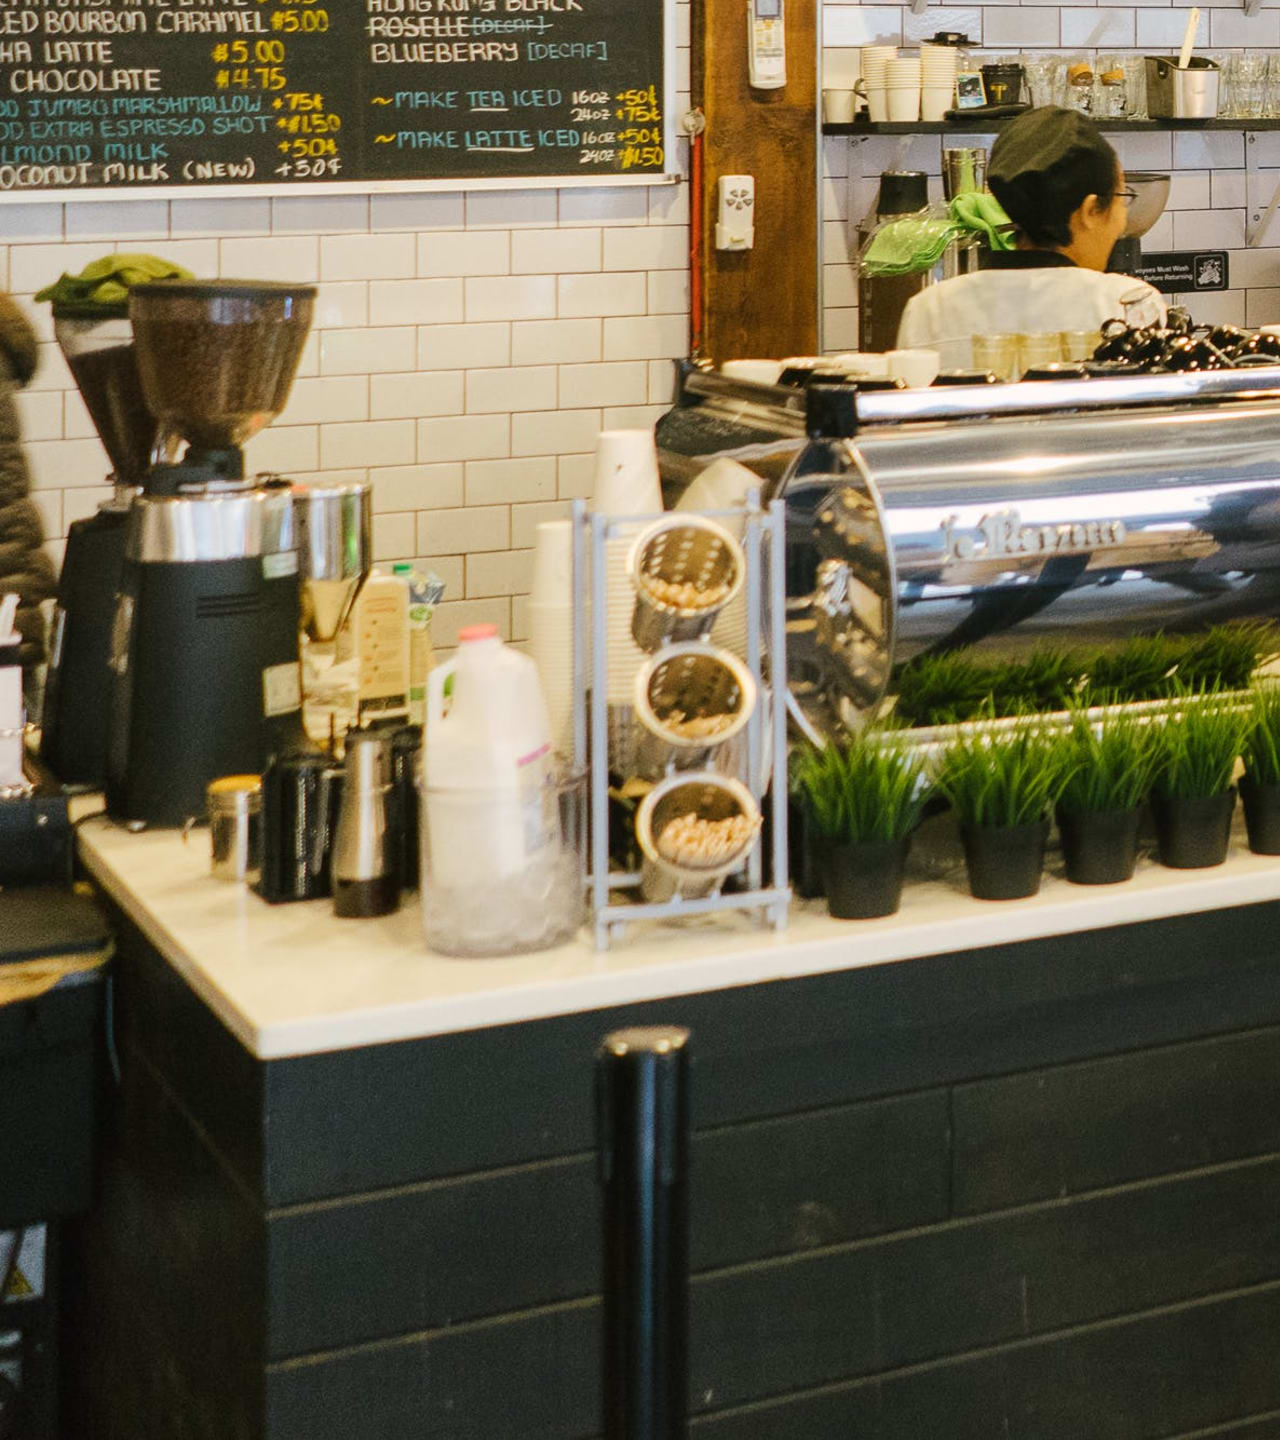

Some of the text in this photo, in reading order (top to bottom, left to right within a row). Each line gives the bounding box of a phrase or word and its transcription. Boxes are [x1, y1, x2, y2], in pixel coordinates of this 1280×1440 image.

[44, 10, 148, 35] BOURBON
[368, 16, 469, 38] ROSELLE
[44, 40, 114, 63] LATTE
[212, 39, 286, 64] $5.00
[371, 41, 519, 63] BLUEBERRY
[10, 68, 162, 94] CHOCOLATE
[28, 98, 109, 118] JUMBO
[112, 95, 262, 116] MARSHMALLOW
[394, 90, 460, 109] MAKE
[468, 90, 506, 107] TEA
[513, 88, 562, 107] ICED
[29, 120, 94, 140] EXTRA
[101, 116, 206, 138] ESPRESSO
[212, 115, 275, 135] SHOT
[397, 129, 460, 149] MAKE
[466, 129, 535, 148] LATTE
[538, 129, 580, 147] ICED
[103, 143, 170, 161] MILK
[103, 162, 169, 184] MILK
[182, 157, 256, 179] (NEW)
